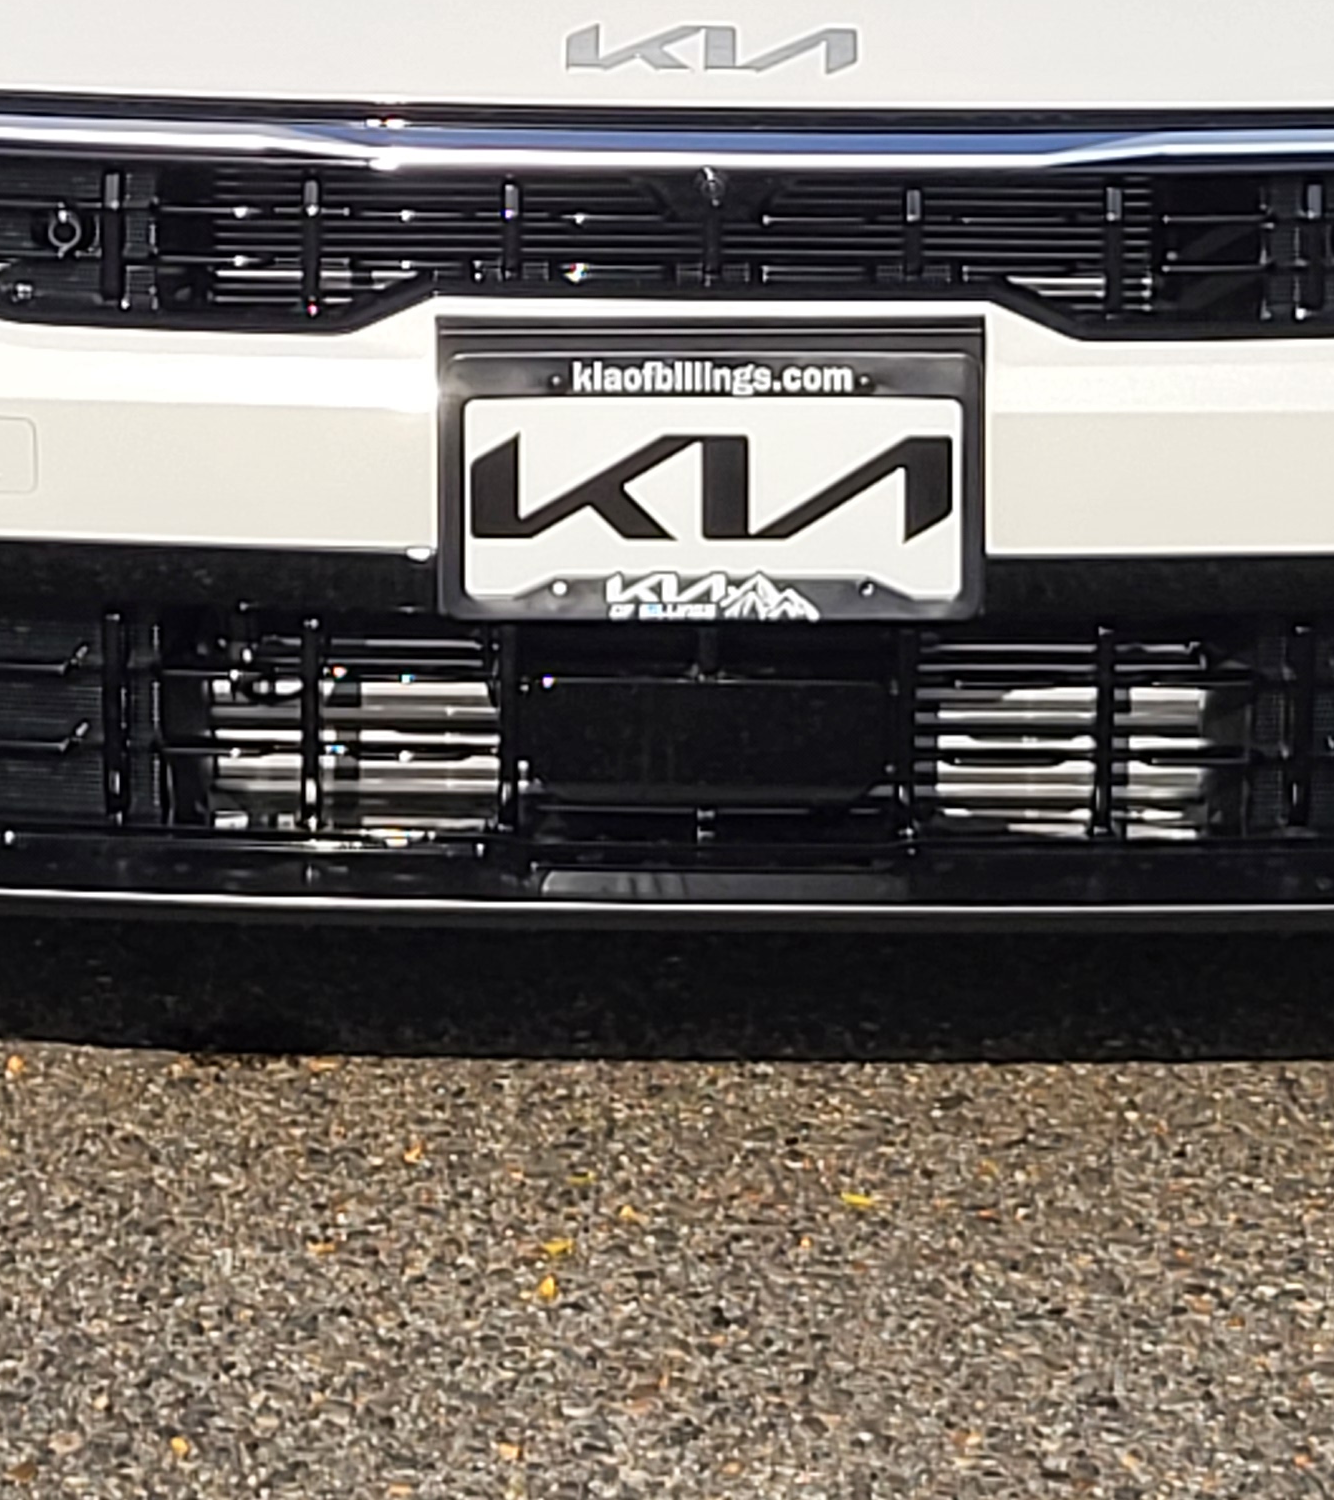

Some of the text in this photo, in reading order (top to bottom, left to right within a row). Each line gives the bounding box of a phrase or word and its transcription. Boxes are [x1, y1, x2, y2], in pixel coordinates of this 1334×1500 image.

[566, 23, 858, 75] KIA
[571, 360, 854, 396] kiaofbillings.com
[469, 430, 954, 544] KIA
[605, 572, 727, 603] KIA
